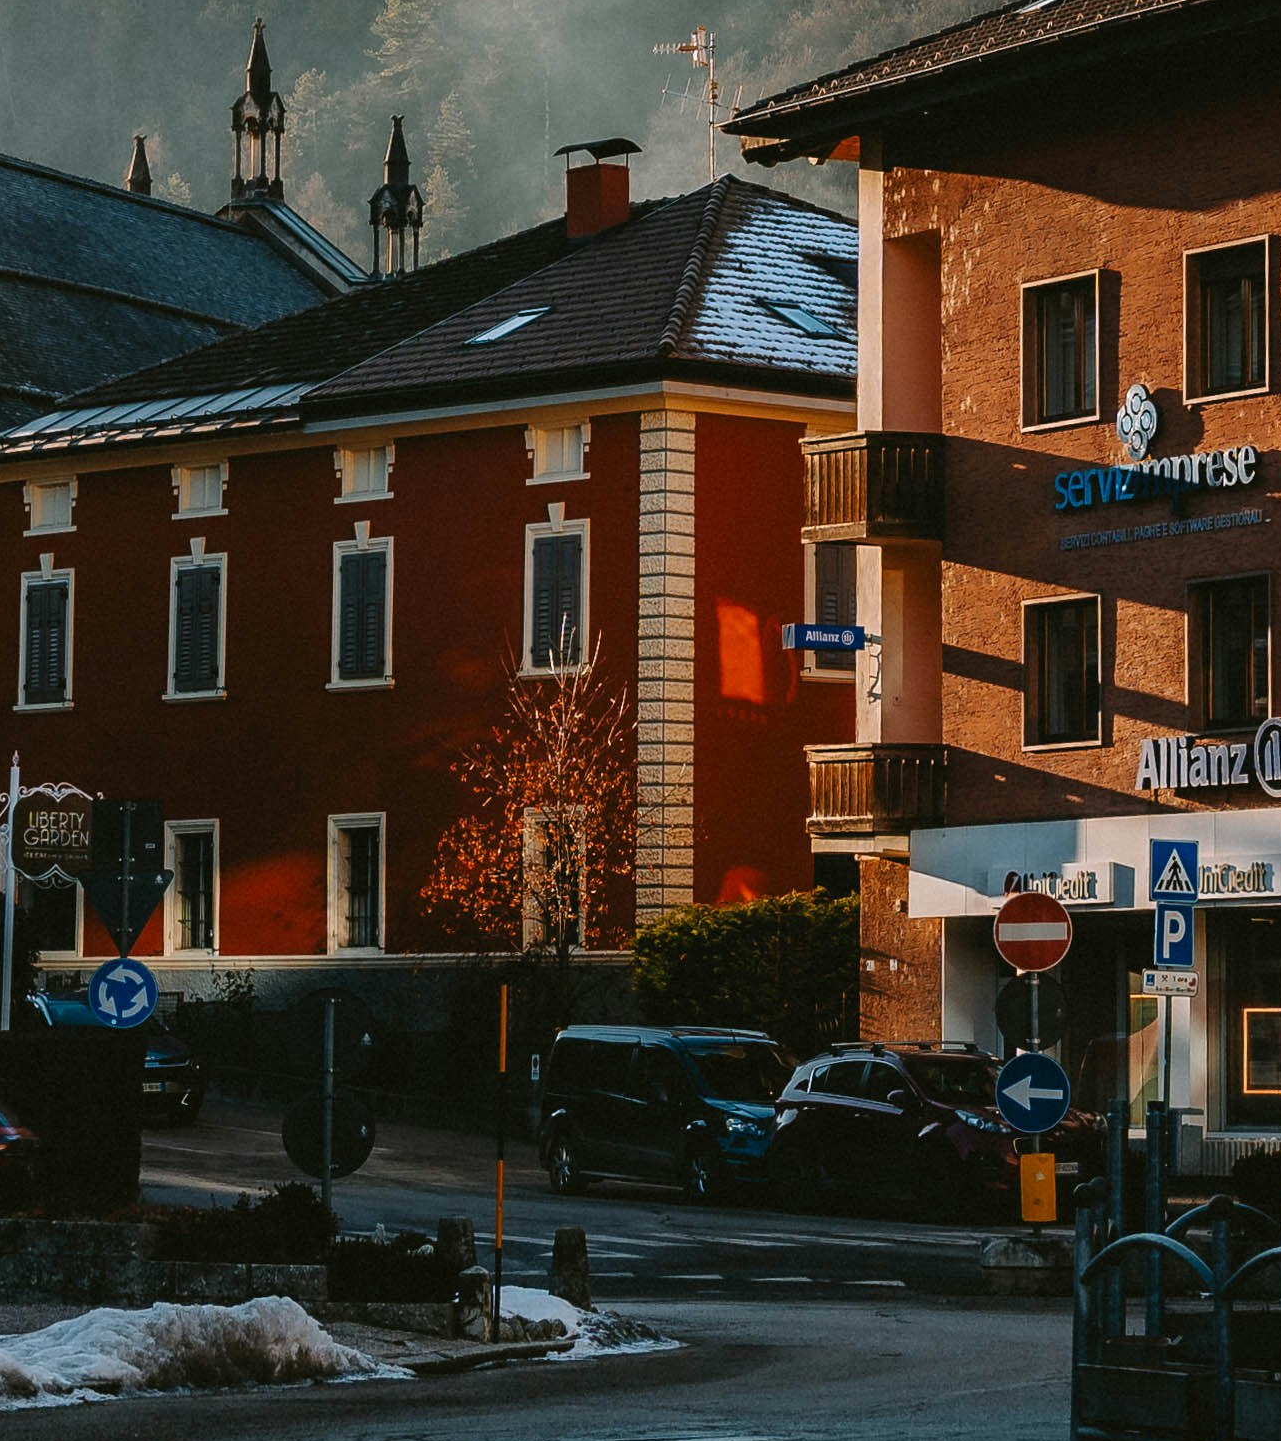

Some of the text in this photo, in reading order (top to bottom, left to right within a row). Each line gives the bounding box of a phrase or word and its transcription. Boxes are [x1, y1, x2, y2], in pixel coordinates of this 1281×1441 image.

[1059, 533, 1090, 551] SERVIZI
[1169, 516, 1214, 536] SOFTWARE
[805, 630, 840, 643] Allianz
[1134, 736, 1250, 791] Allianz
[29, 811, 85, 829] LIBERTY
[23, 828, 89, 847] GARDEN
[1163, 909, 1186, 959] P
